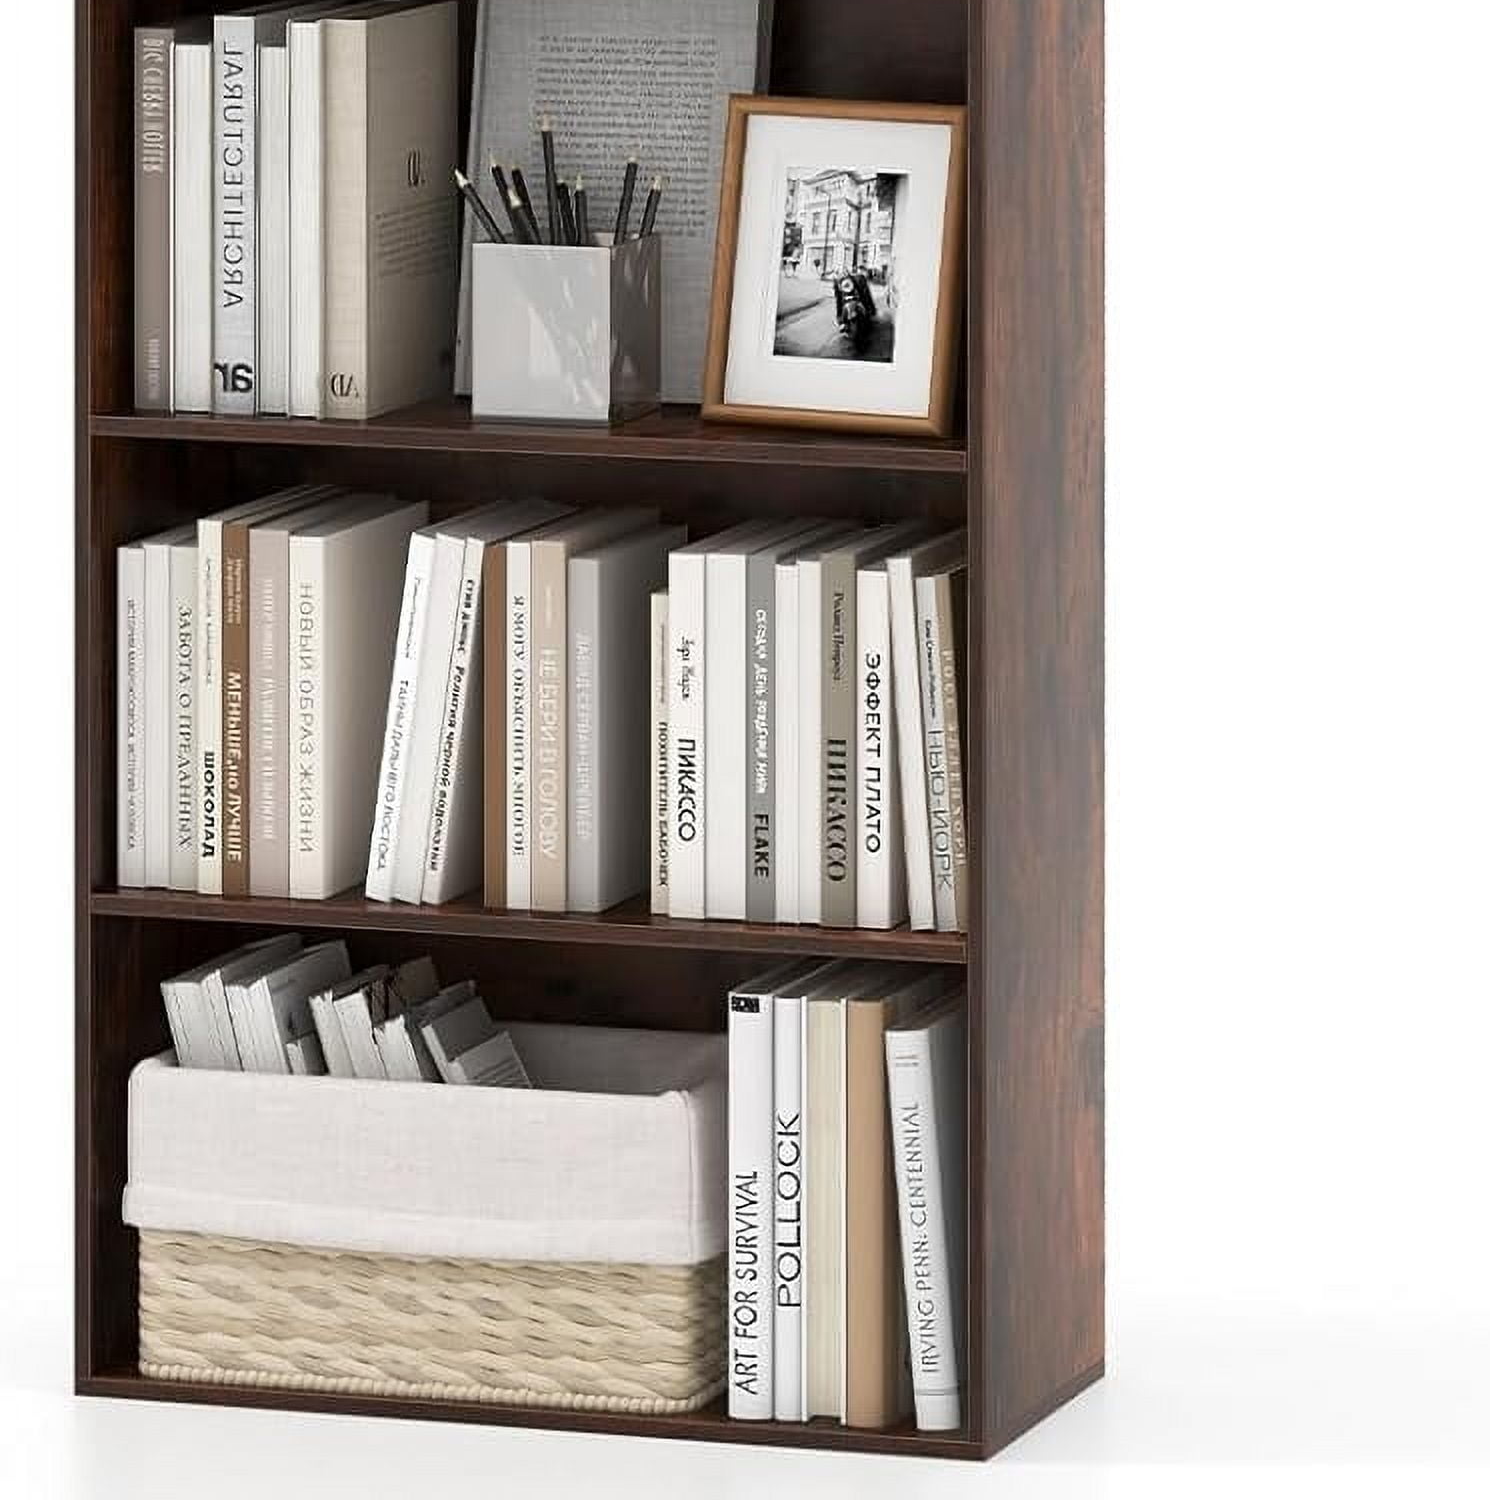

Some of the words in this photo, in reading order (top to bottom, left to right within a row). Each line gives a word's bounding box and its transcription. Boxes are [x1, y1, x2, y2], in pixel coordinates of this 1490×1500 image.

[512, 595, 525, 606] Я
[512, 611, 525, 661] МОГУ
[178, 606, 193, 684] ЗАБОТА
[178, 693, 193, 709] О
[299, 680, 314, 755] ОБРАЗ
[538, 683, 559, 743] БЕРИ
[865, 653, 881, 757] ЭФФЕКТ
[178, 715, 193, 848] ПРЕДАННЫХ
[202, 750, 216, 858] ШОКОЛАД
[299, 764, 314, 853] ЖИЗНИ
[538, 768, 559, 859] ГОЛОВУ
[677, 738, 697, 842] ПИКАССО
[825, 738, 848, 882] ПИКАССО
[865, 765, 881, 853] ПЛАТО
[754, 813, 769, 877] FLAKE
[900, 1102, 929, 1228] CENTENNIAL
[733, 1171, 759, 1282] SURVIVAL
[777, 1113, 801, 1308] POLLOCK
[911, 1233, 932, 1291] PENN:
[733, 1290, 759, 1340] FOR
[916, 1299, 940, 1373] IRVING
[733, 1349, 759, 1395] ART
